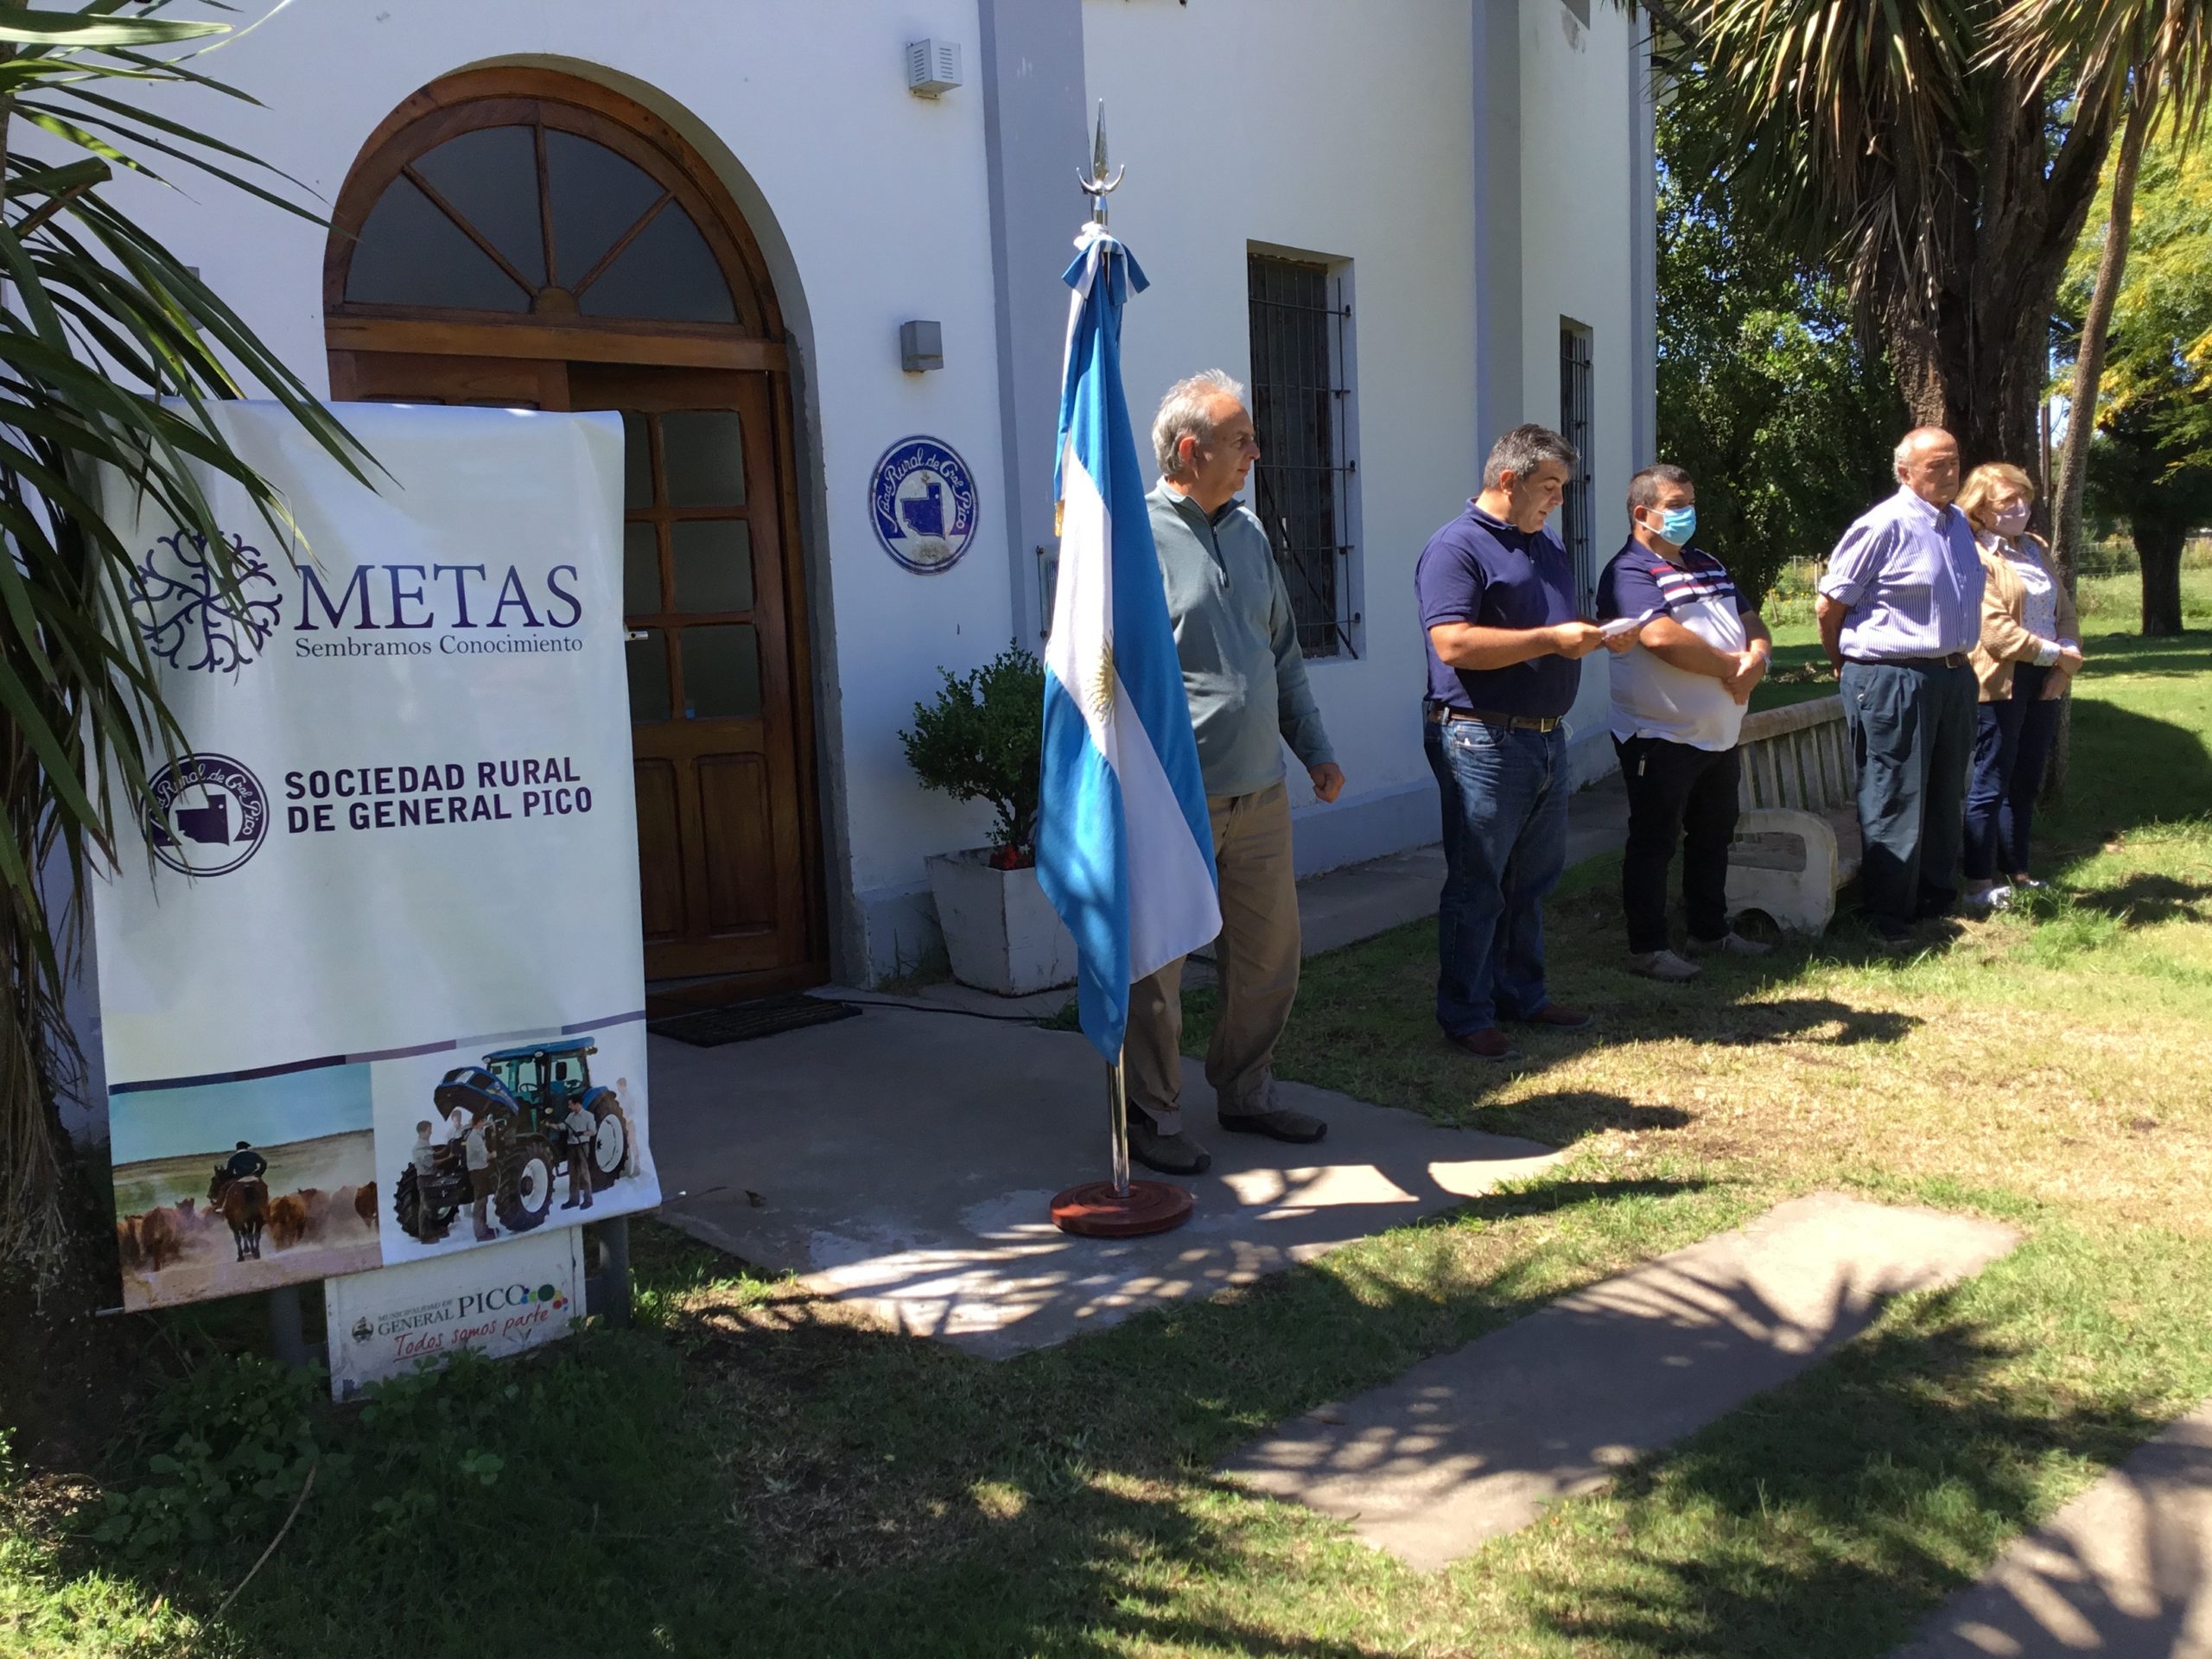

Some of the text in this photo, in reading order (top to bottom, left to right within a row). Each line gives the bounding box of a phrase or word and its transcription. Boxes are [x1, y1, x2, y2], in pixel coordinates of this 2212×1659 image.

[884, 448, 925, 497] Rural
[925, 454, 939, 470] de
[952, 485, 971, 529] Pico
[294, 563, 582, 630] METAS
[296, 634, 583, 658] Sembramos Conocimiento
[207, 769, 225, 784] de
[225, 773, 252, 798] Gral
[239, 796, 261, 835] Pico
[285, 757, 581, 799] SOCIEDAD RURAL
[288, 786, 592, 833] DE GENERAL PICO
[378, 1284, 526, 1336] GENERAL PICO
[394, 1332, 443, 1357] Todos
[503, 1304, 548, 1337] parte
